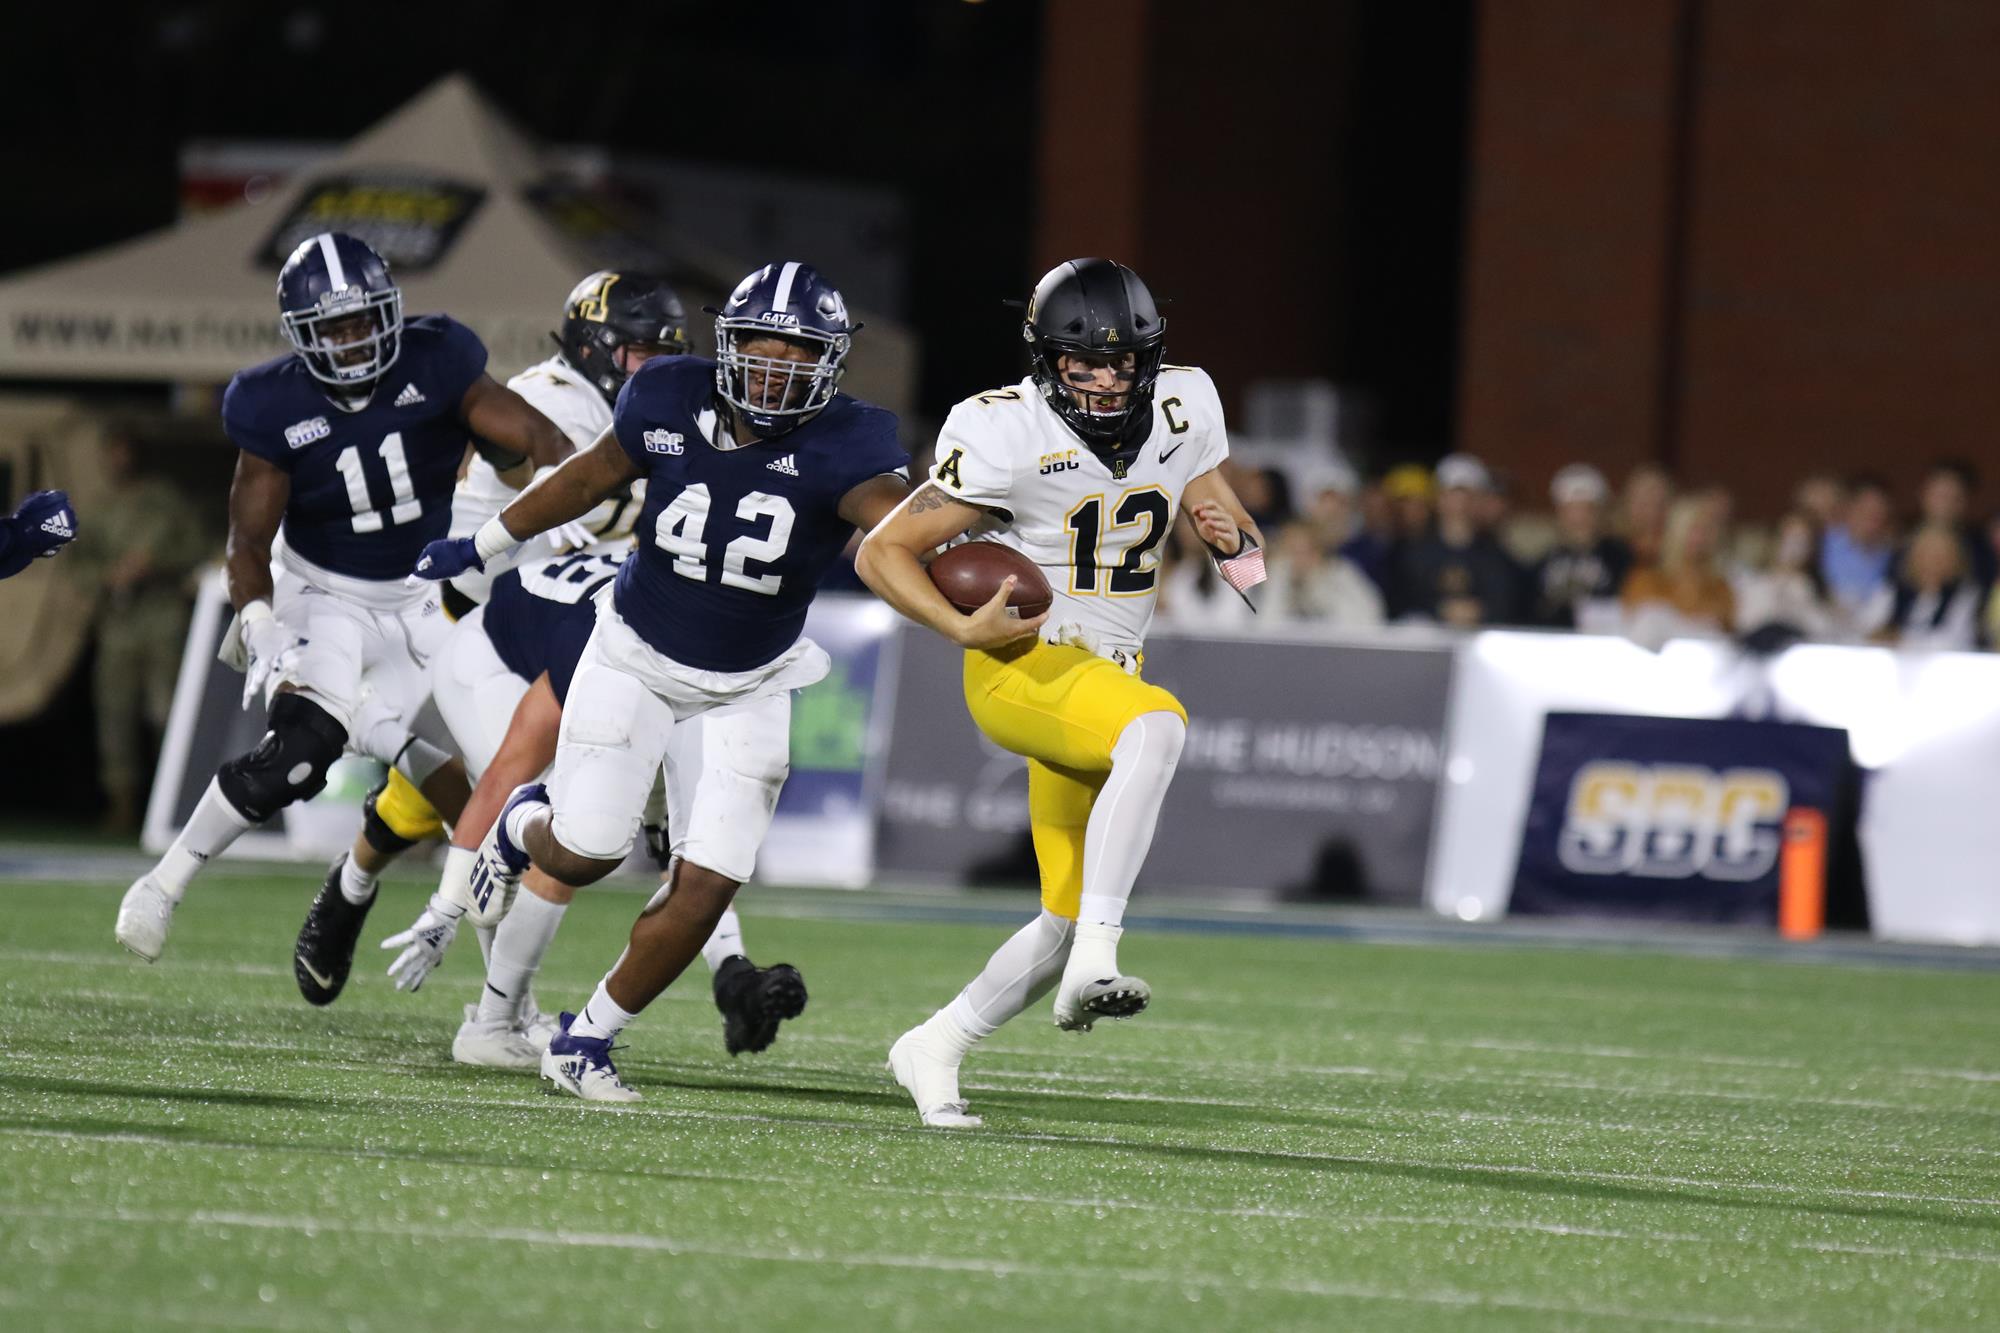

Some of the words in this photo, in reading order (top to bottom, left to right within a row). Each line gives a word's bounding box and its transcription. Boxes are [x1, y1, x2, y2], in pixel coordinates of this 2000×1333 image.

[1161, 396, 1190, 435] C
[335, 431, 423, 534] 11
[766, 462, 800, 477] adidas
[936, 447, 964, 490] A
[1039, 449, 1080, 476] SBC
[1113, 459, 1128, 481] A
[40, 522, 73, 538] adidas
[654, 482, 796, 596] 42
[1063, 482, 1173, 598] 12
[1558, 759, 1790, 882] SBC
